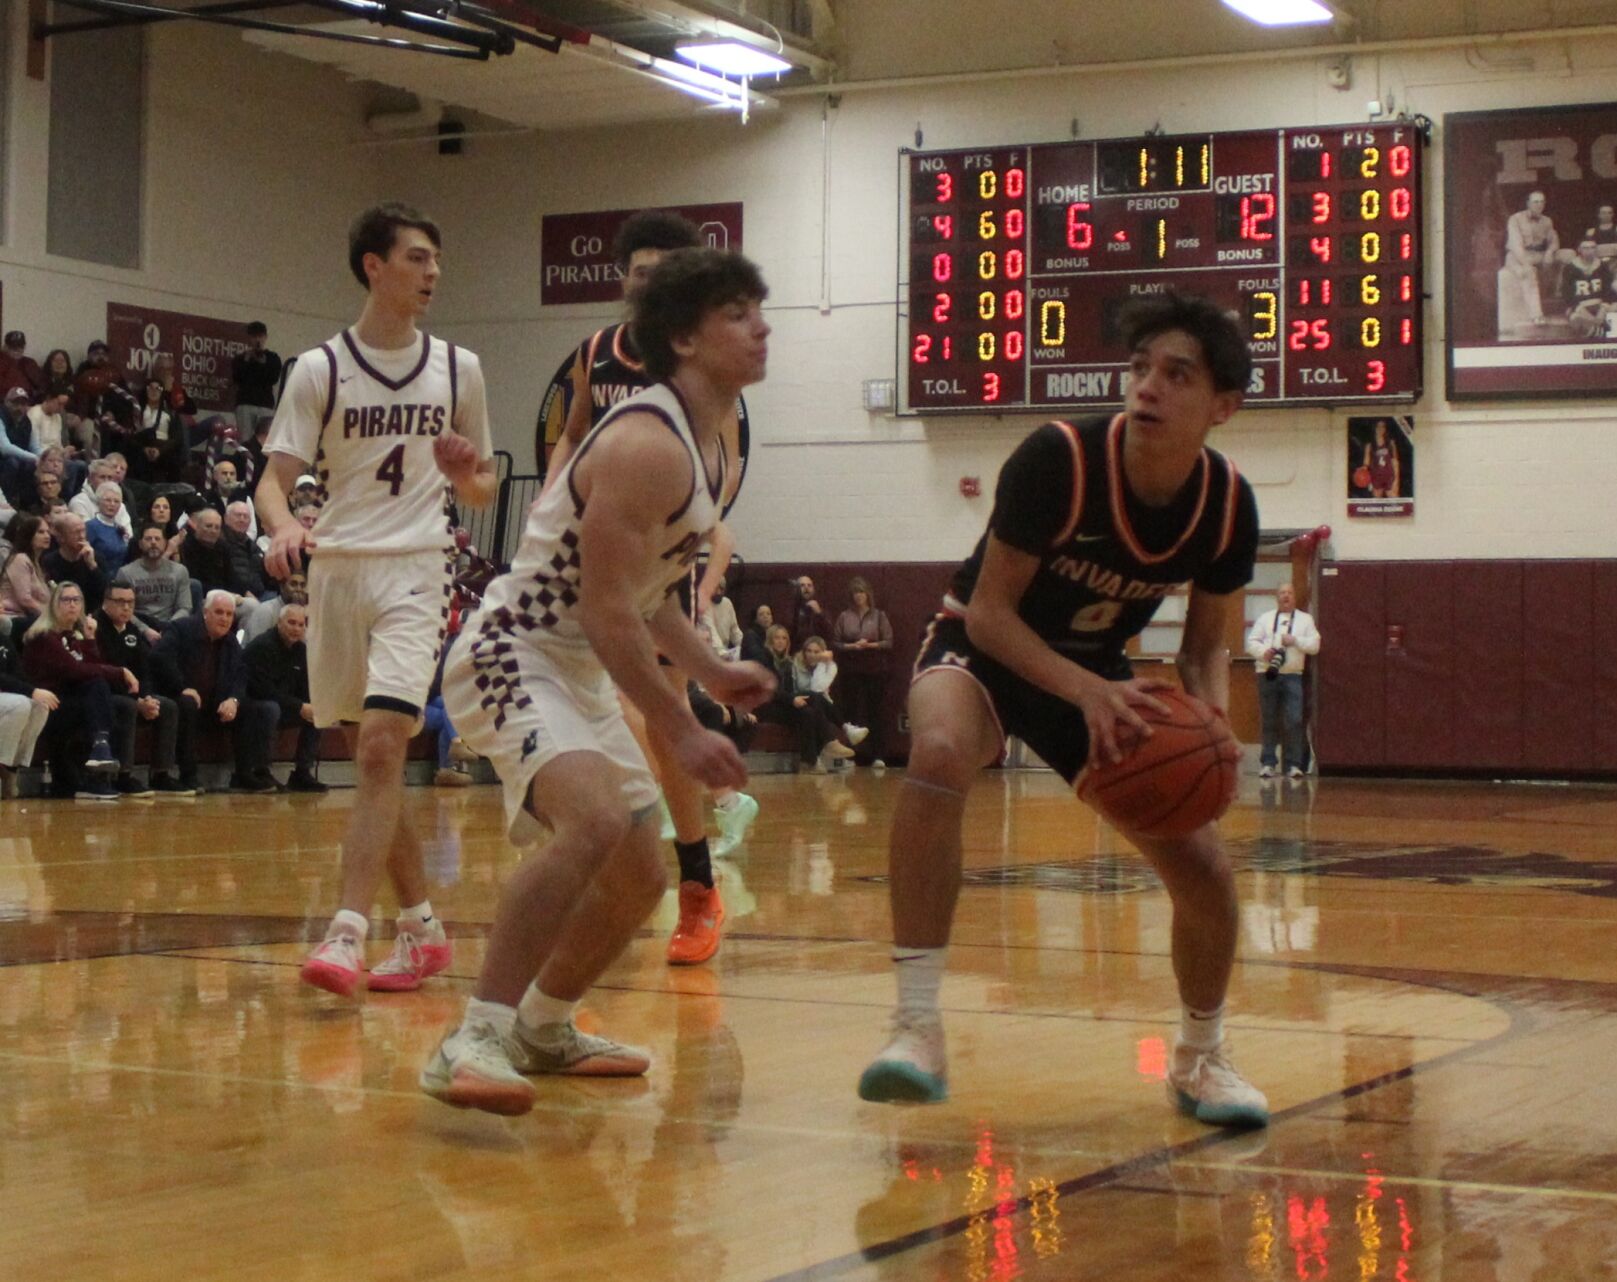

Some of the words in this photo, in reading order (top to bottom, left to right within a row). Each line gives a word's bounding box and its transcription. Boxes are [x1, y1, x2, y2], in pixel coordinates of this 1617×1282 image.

[1293, 134, 1323, 149] NO.
[1394, 129, 1404, 143] F
[920, 157, 947, 171] NO.
[964, 154, 992, 169] PTS
[1010, 153, 1019, 166] F
[1139, 143, 1209, 187] 1:11
[1321, 152, 1330, 177] 1
[1360, 147, 1379, 178] 2
[1389, 145, 1411, 177] 0
[936, 172, 952, 203] 3
[979, 170, 997, 199] 0
[1005, 168, 1024, 198] 0
[1038, 184, 1089, 204] HOME
[1215, 174, 1274, 194] GUEST
[1127, 198, 1180, 211] PERIOD
[1239, 192, 1276, 241] 12
[1312, 191, 1330, 224] 3
[1360, 189, 1380, 221] 0
[1389, 187, 1411, 220] 0
[934, 214, 951, 239] 4
[979, 210, 996, 239] 6
[1005, 208, 1024, 238] 0
[1065, 202, 1093, 249] 6
[571, 235, 603, 257] GO
[1107, 242, 1131, 251] POSS
[1158, 218, 1167, 259] 1
[1175, 239, 1200, 248] POSS
[1310, 236, 1330, 263] 4
[1360, 231, 1380, 263] 0
[1401, 233, 1411, 260] 1
[933, 252, 951, 282] 0
[979, 251, 996, 280] 0
[1004, 249, 1024, 279] 0
[1046, 257, 1089, 270] BONUS
[1217, 248, 1263, 261] BONUS
[546, 262, 625, 286] PIRATES
[1238, 279, 1280, 291] FOULS
[1031, 288, 1070, 299] FOULS
[1299, 279, 1331, 304] 11
[1361, 274, 1380, 305] 6
[1401, 275, 1411, 301] 1
[934, 292, 951, 323] 2
[978, 291, 996, 320] 0
[1004, 289, 1024, 319] 0
[1253, 291, 1277, 340] 3
[1040, 299, 1066, 346] 0
[1289, 318, 1331, 350] 25
[1360, 316, 1380, 348] 0
[1401, 318, 1411, 344] 1
[182, 335, 253, 358] NORTHER
[913, 333, 952, 363] 21
[978, 331, 996, 361] 0
[1004, 330, 1023, 361] 0
[1034, 348, 1065, 359] WON
[182, 353, 217, 374] OHIO
[1299, 367, 1348, 384] T.O.L.
[1366, 359, 1386, 392] 3
[182, 372, 207, 386] BUICK
[922, 378, 967, 395] T.O.L.
[983, 372, 1000, 402] 3
[1047, 371, 1113, 398] ROCKY
[344, 403, 446, 439] PIRATES
[375, 444, 406, 496] 4
